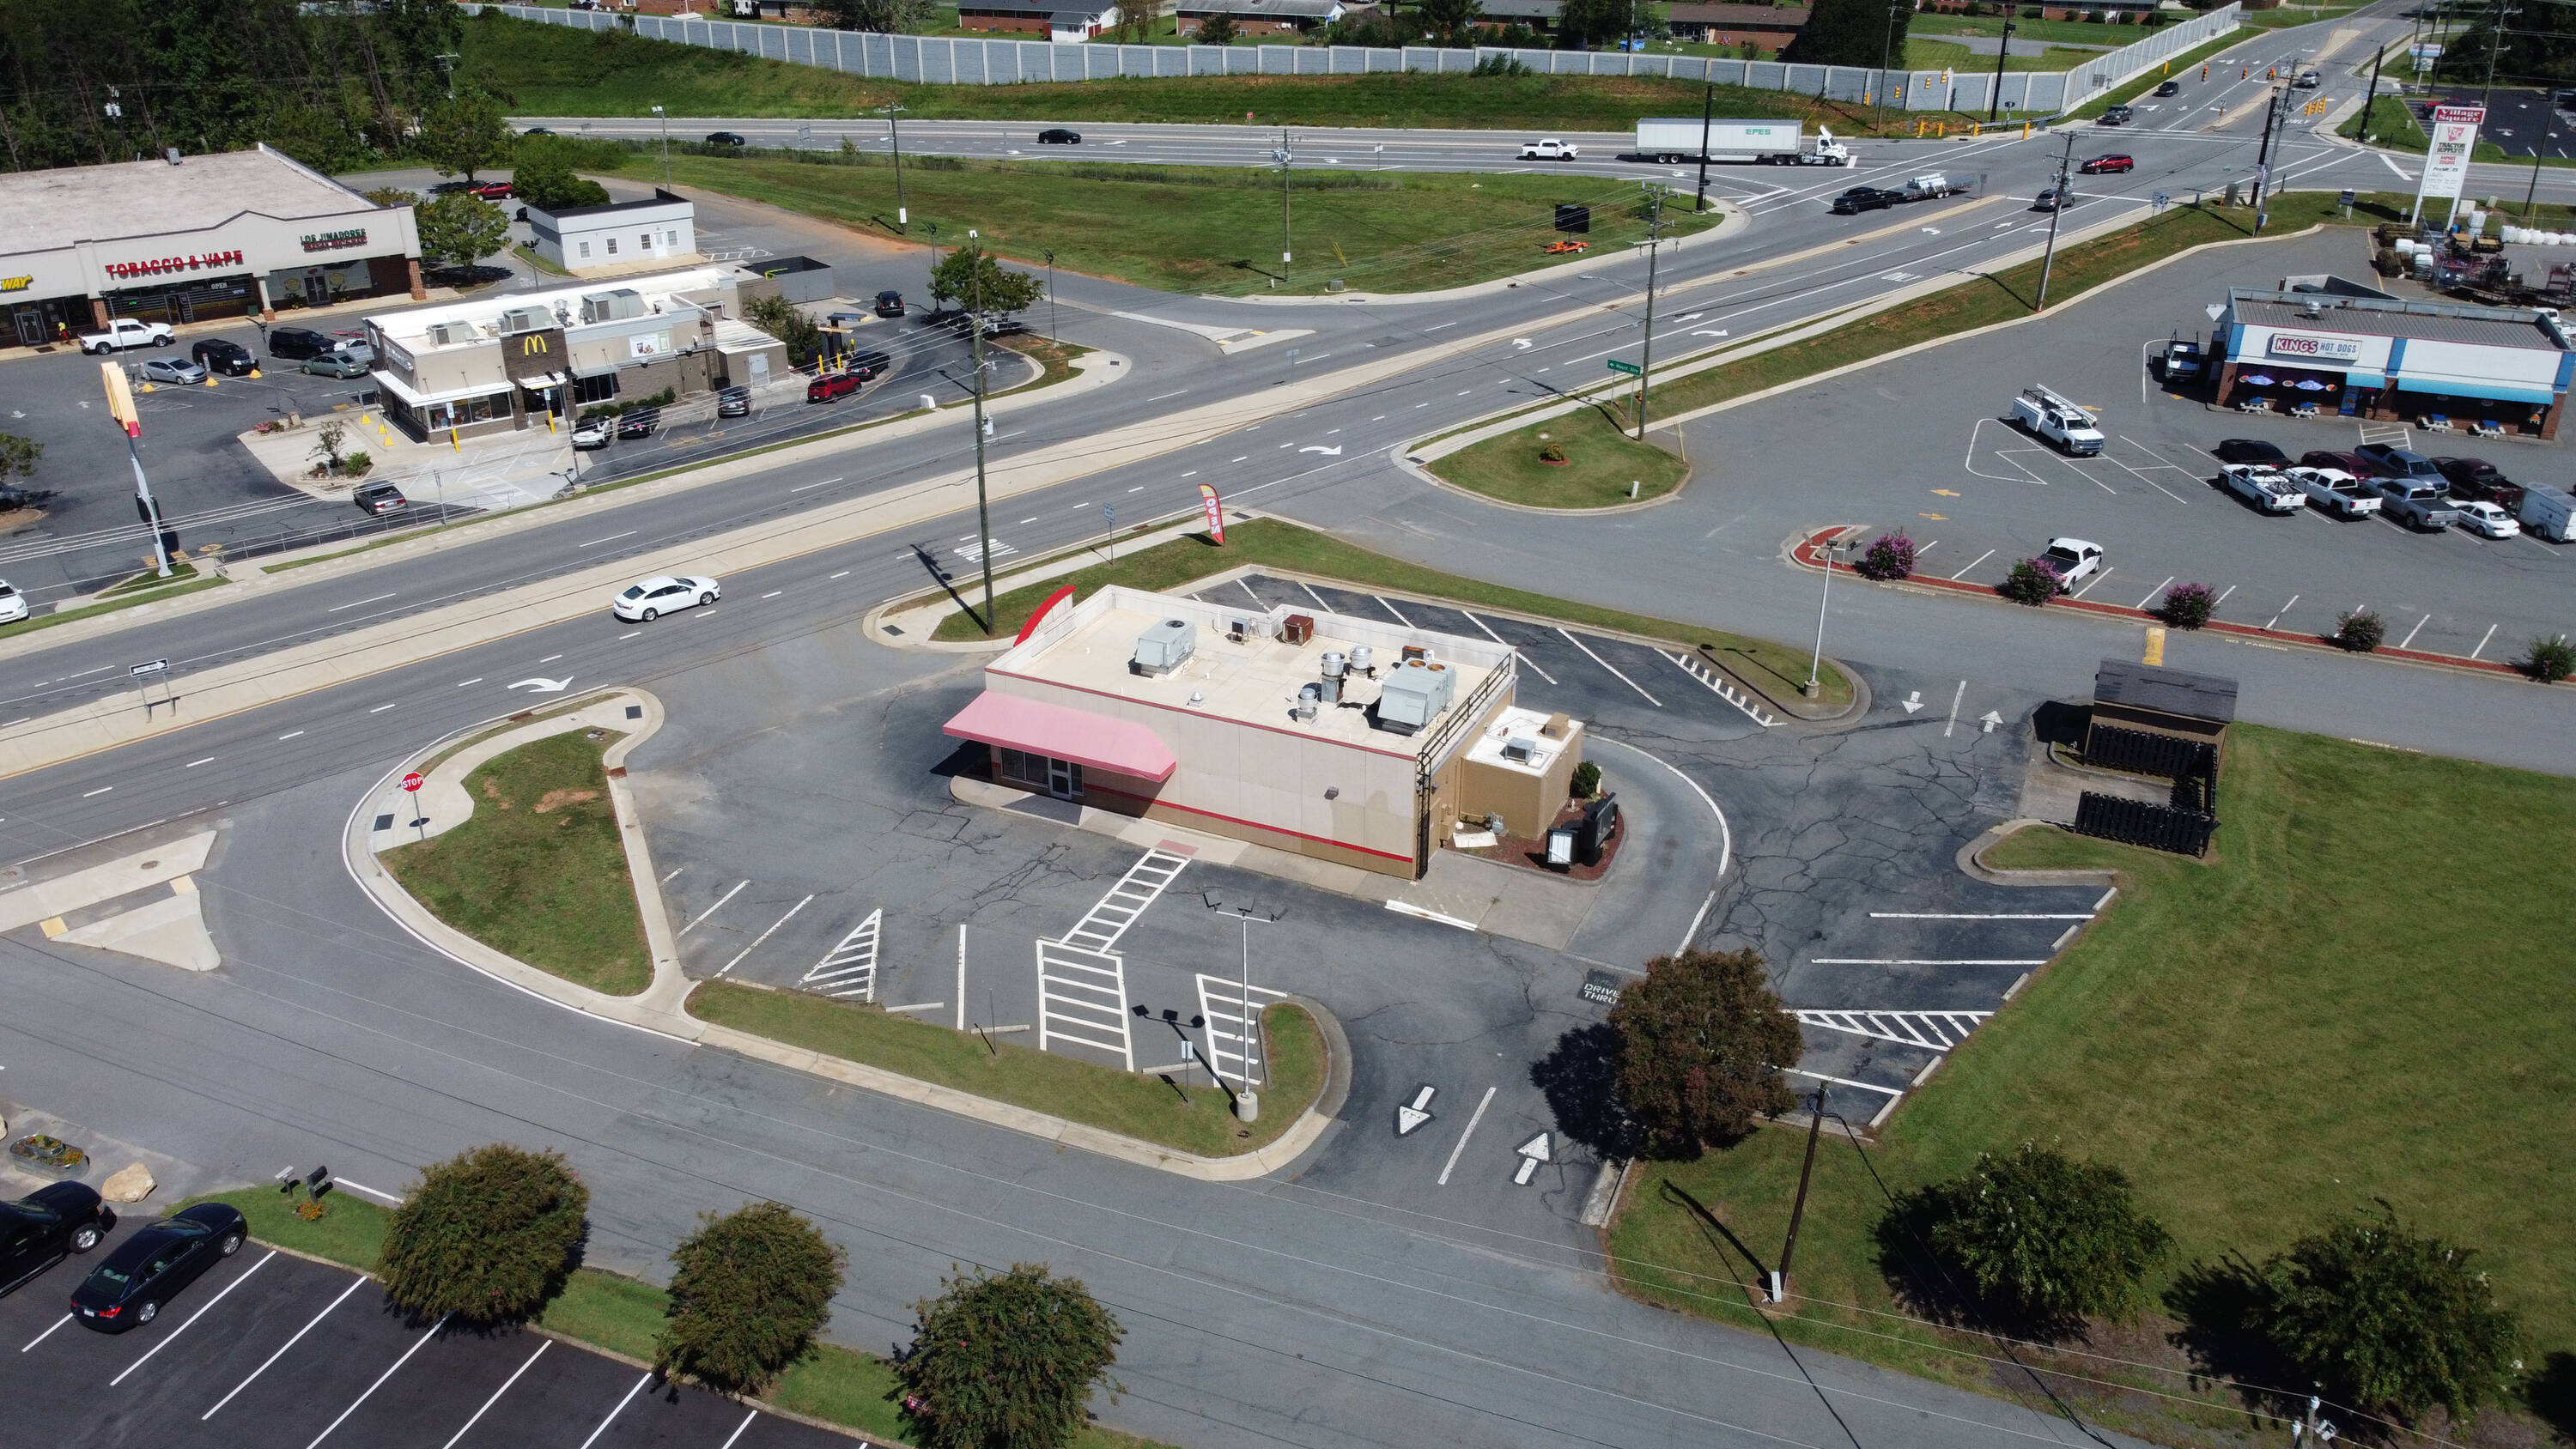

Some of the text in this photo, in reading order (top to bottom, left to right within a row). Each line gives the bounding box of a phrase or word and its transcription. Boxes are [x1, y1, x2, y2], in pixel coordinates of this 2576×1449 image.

[2437, 114, 2479, 123] Square
[2441, 109, 2481, 118] Village
[300, 228, 367, 245] LOS JIMADORES
[106, 250, 243, 276] TOBACCO & VAPE
[0, 275, 32, 290] WAY
[2275, 338, 2357, 354] KINGS HOT DOGS
[402, 776, 422, 789] STOP
[1583, 983, 1620, 999] DRIVE
[1583, 990, 1618, 1004] THRU
